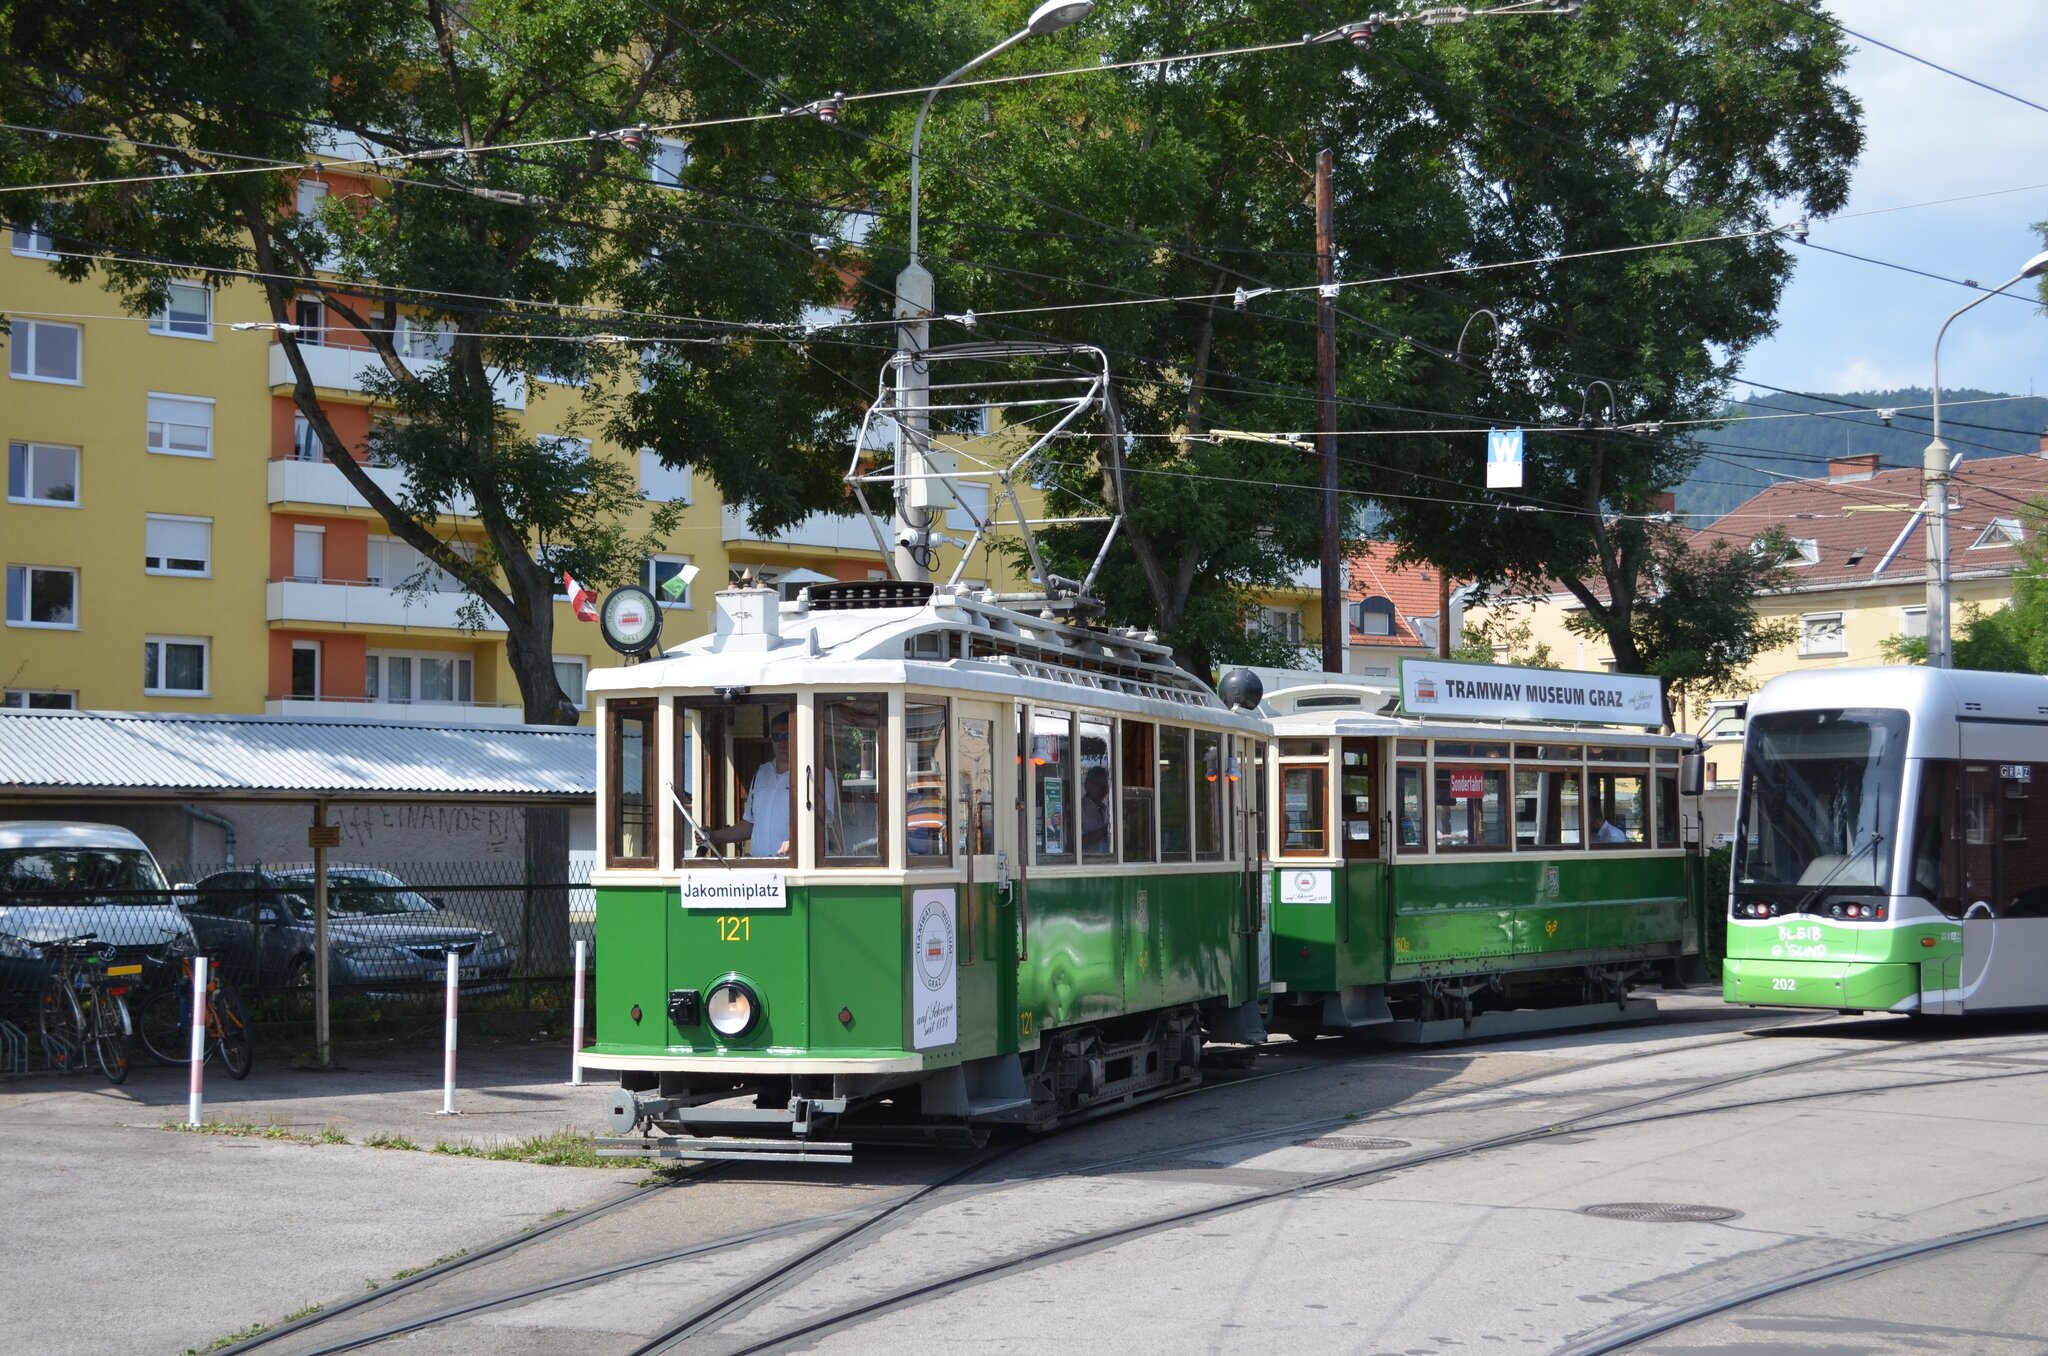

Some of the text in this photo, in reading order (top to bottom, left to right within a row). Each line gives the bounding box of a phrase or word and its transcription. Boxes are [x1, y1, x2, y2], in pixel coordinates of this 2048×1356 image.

[1491, 436, 1520, 463] W
[1445, 679, 1522, 702] TRAMWAY
[1526, 685, 1586, 706] MUSEUM
[1589, 689, 1624, 708] GRAZ
[2000, 765, 2030, 778] GRAZ
[684, 883, 779, 901] Jakominiplatz
[716, 915, 750, 941] 121
[917, 908, 952, 954] TRAMWAY MUSEUM
[1778, 925, 1822, 942] BLEIB
[927, 978, 942, 988] GRAZ
[1771, 977, 1796, 991] 202
[1020, 1011, 1033, 1036] 121
